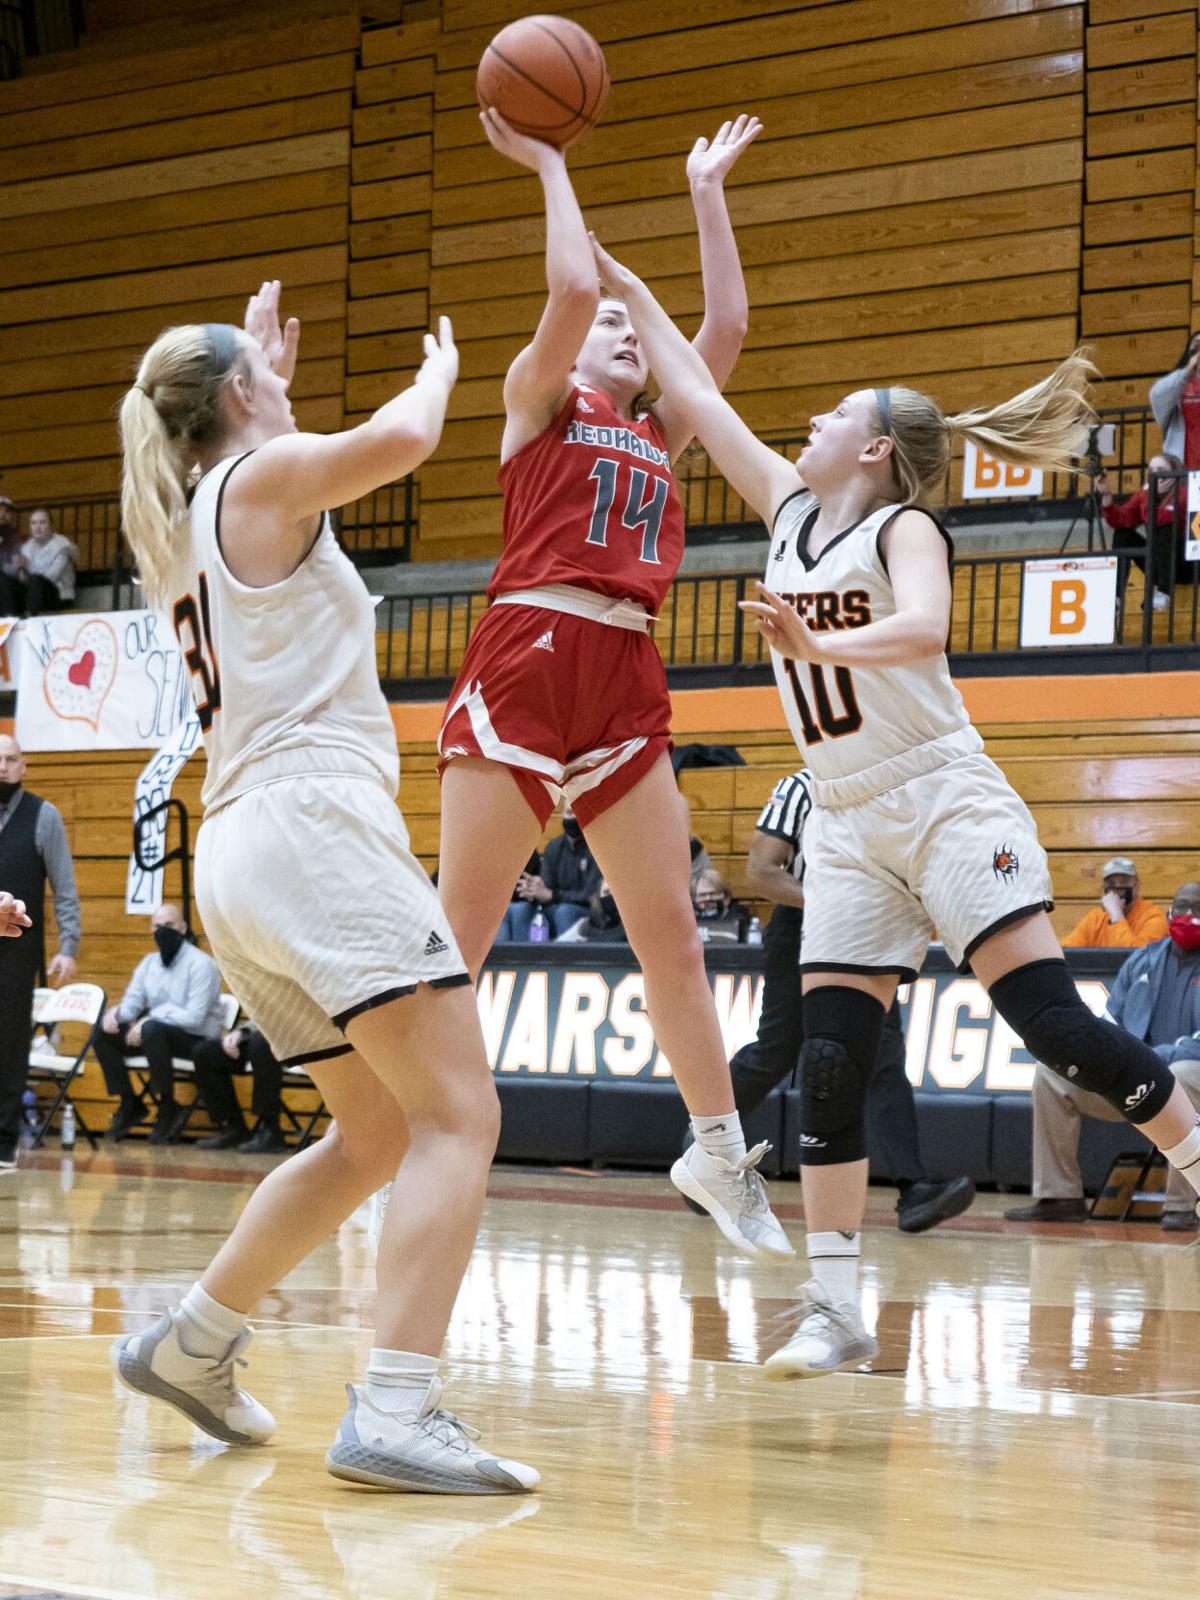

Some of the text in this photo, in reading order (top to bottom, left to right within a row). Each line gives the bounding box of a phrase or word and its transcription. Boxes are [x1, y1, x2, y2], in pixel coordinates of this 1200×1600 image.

[585, 457, 669, 565] 14
[125, 615, 160, 660] OUR
[172, 570, 222, 734] 31
[1049, 579, 1087, 635] B
[783, 656, 863, 747] 10
[476, 970, 766, 1077] WARSW
